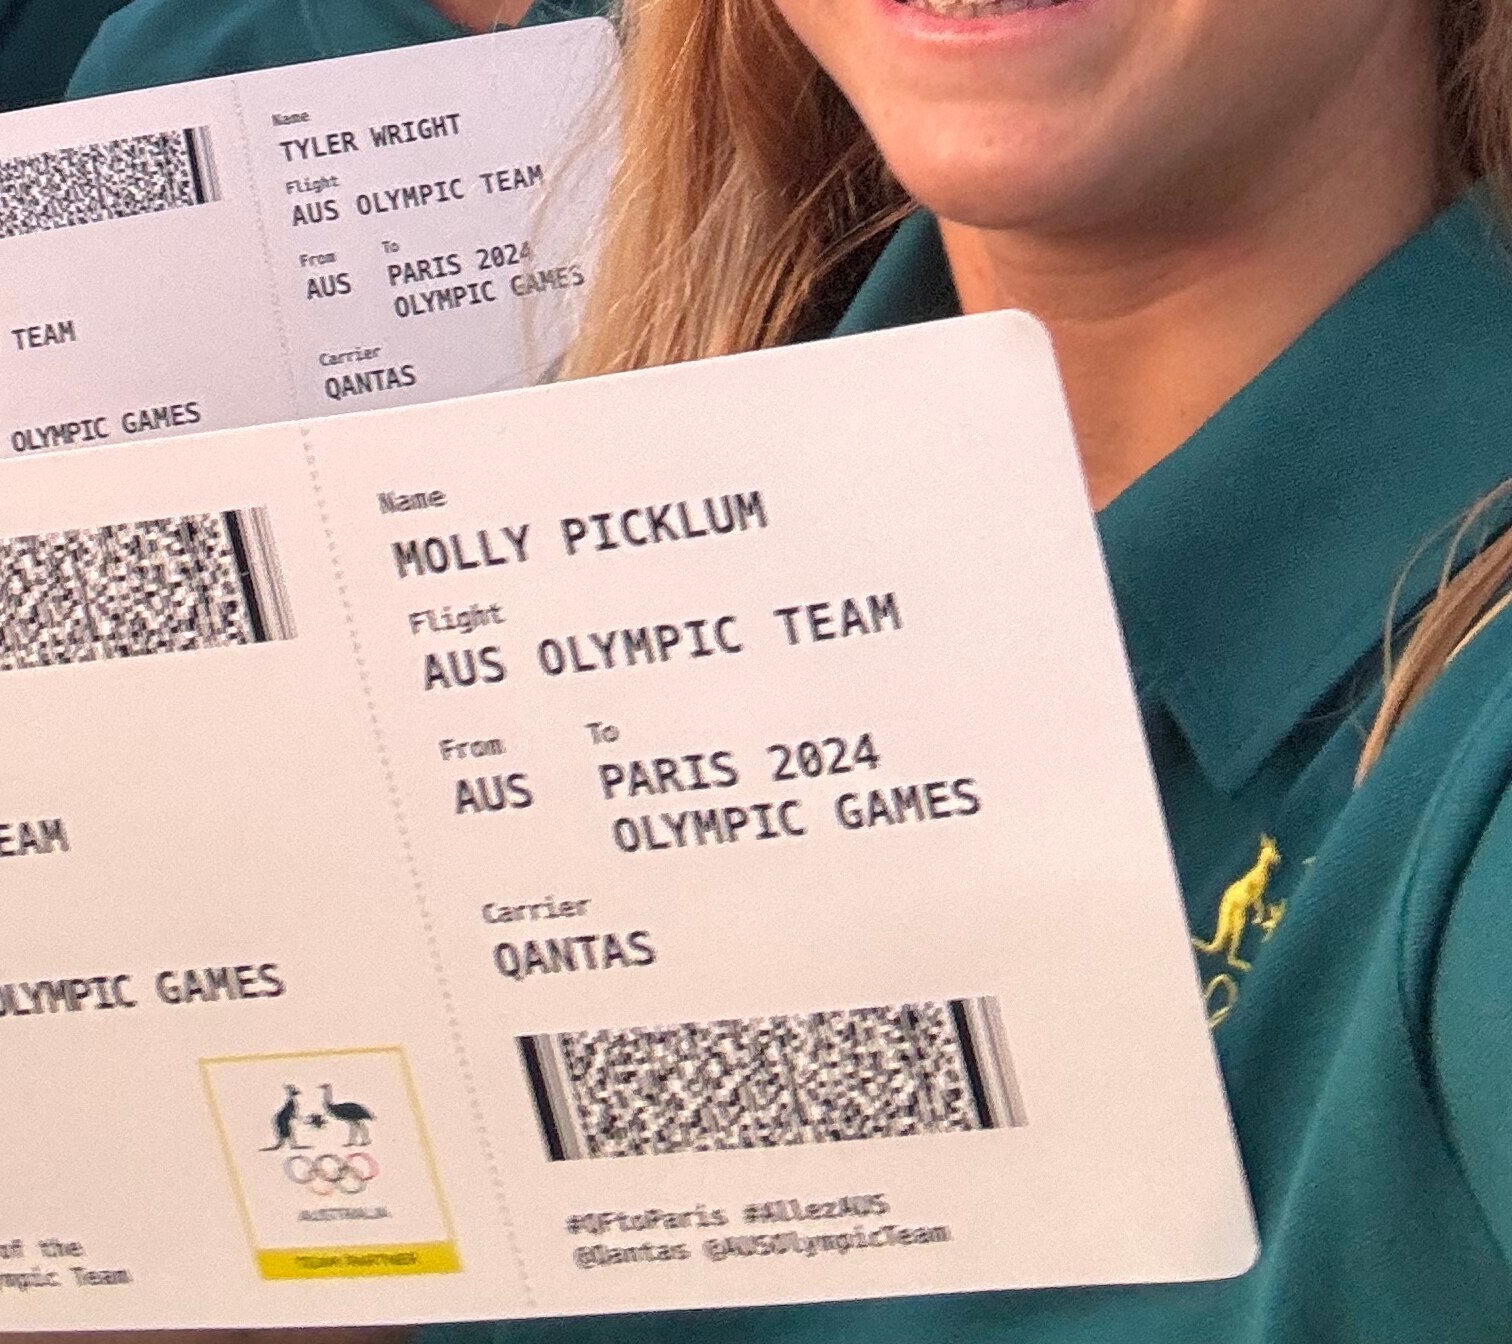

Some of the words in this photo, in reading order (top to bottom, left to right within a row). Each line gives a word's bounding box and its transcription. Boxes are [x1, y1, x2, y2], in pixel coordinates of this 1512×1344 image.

[271, 111, 311, 127] Name
[278, 131, 360, 162] TYLER
[369, 112, 461, 148] WRIGHT
[285, 175, 341, 195] Flight
[292, 199, 340, 227] AUS
[355, 177, 465, 216] OLYMPIC
[478, 164, 545, 194] TEAM
[298, 252, 337, 268] From
[380, 240, 401, 254] To
[387, 253, 463, 287] PARIS
[476, 241, 530, 270] 2024
[306, 272, 352, 301] AUS
[393, 280, 497, 319] OLYMPIC
[511, 265, 585, 296] GAMES
[10, 319, 77, 351] TEAM
[318, 346, 382, 367] Carrier
[324, 364, 417, 401] QANTAS
[10, 416, 110, 453] OLYMPIC
[121, 401, 202, 435] GAMES
[377, 489, 447, 515] Name
[391, 523, 530, 579] MOLLY
[560, 490, 768, 556] PICKLUM
[407, 603, 506, 635] Flight
[424, 645, 507, 691] AUS
[537, 615, 743, 677] OLYMPIC
[772, 592, 902, 646] TEAM
[584, 721, 620, 745] To
[438, 738, 507, 761] From
[598, 750, 739, 800] PARIS
[766, 733, 881, 782] 2024
[455, 772, 534, 815] AUS
[612, 799, 806, 853] OLYMPIC
[834, 777, 981, 830] GAMES
[481, 899, 592, 925] Carrier
[493, 930, 657, 982] QANTAS
[156, 963, 285, 1004] GAMES
[38, 1238, 84, 1258] the
[69, 1267, 133, 1287] Team
